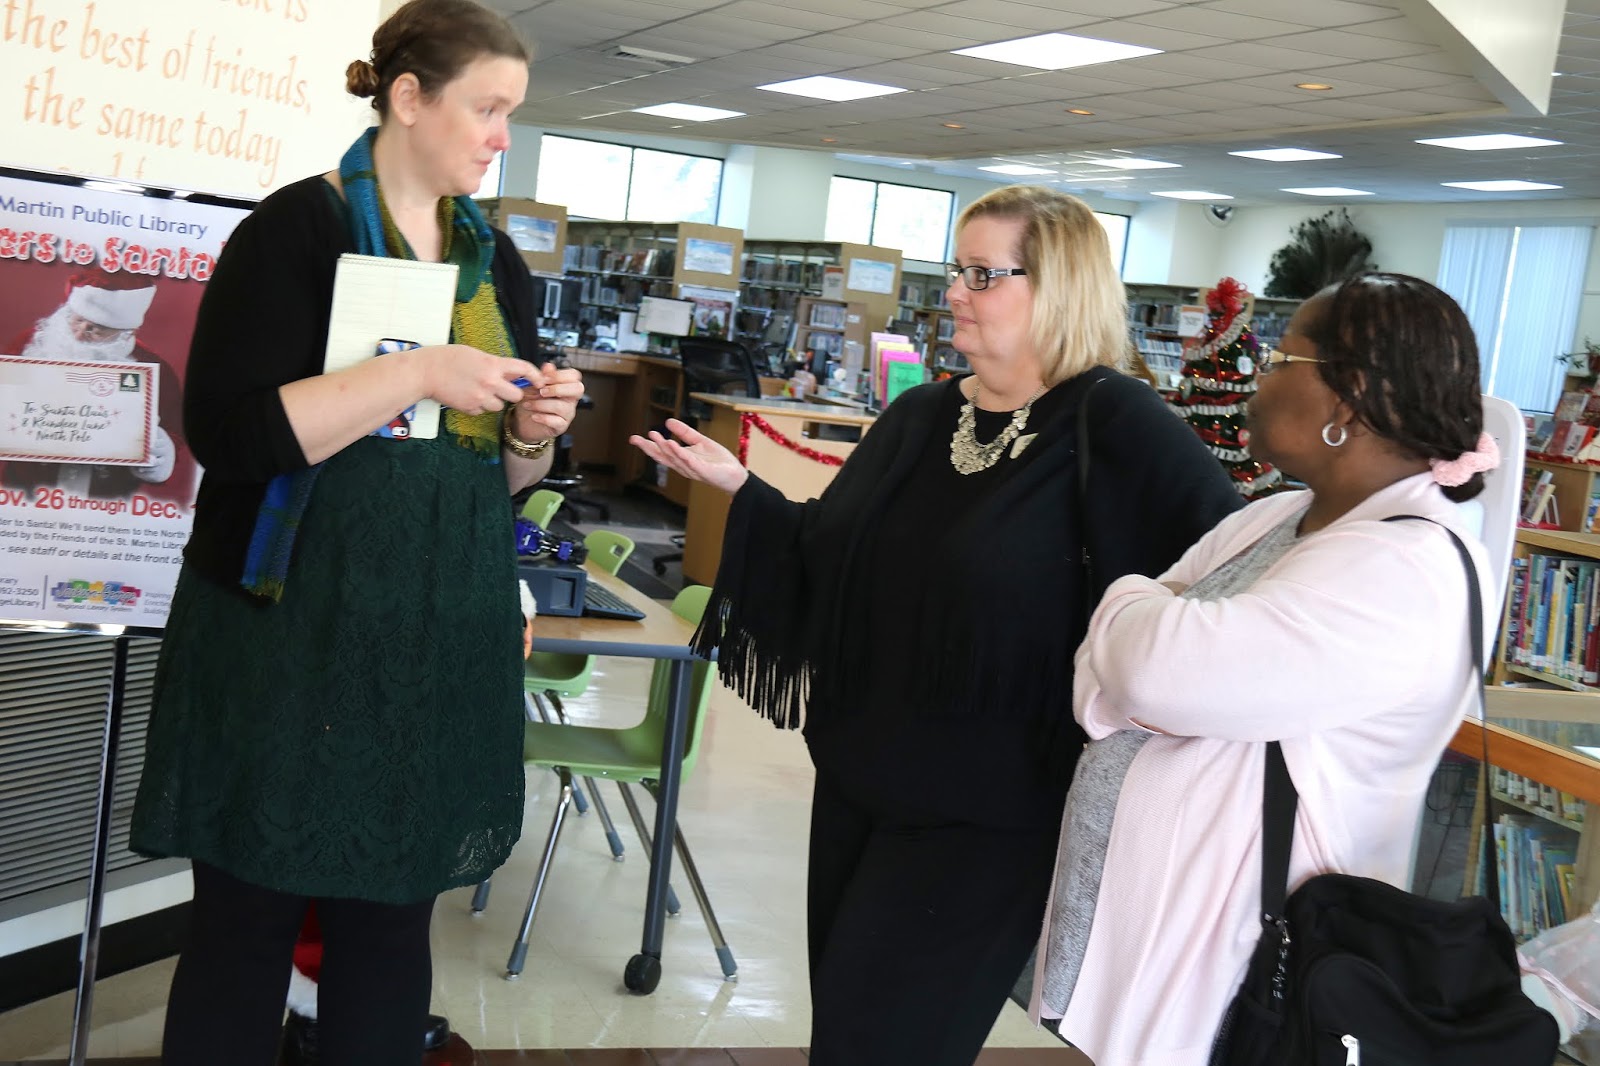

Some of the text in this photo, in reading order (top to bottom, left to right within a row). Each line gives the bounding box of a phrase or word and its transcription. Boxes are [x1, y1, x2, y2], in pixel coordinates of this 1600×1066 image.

[2, 0, 312, 117] the best of friends,
[23, 66, 86, 130] the
[96, 102, 183, 149] same
[193, 108, 283, 188] today
[0, 195, 208, 240] Martin Public Library
[62, 238, 95, 266] to
[101, 236, 218, 282] Santa
[41, 403, 75, 416] Santa
[80, 404, 109, 418] Claus
[70, 429, 92, 442] Pole
[35, 487, 65, 510] 26
[68, 496, 127, 515] through
[132, 495, 182, 519] Dec.
[20, 531, 32, 541] by
[34, 532, 49, 540] the
[51, 532, 86, 543] Friends
[88, 535, 98, 544] of
[99, 537, 114, 545] the
[131, 538, 160, 548] Martin
[83, 524, 106, 533] send
[107, 526, 131, 535] them
[132, 527, 142, 536] to
[144, 528, 158, 537] the
[160, 529, 186, 538] North
[7, 546, 28, 554] see
[30, 546, 58, 556] staff
[73, 549, 108, 560] details
[111, 552, 122, 560] at
[125, 552, 141, 561] the
[144, 553, 170, 563] front
